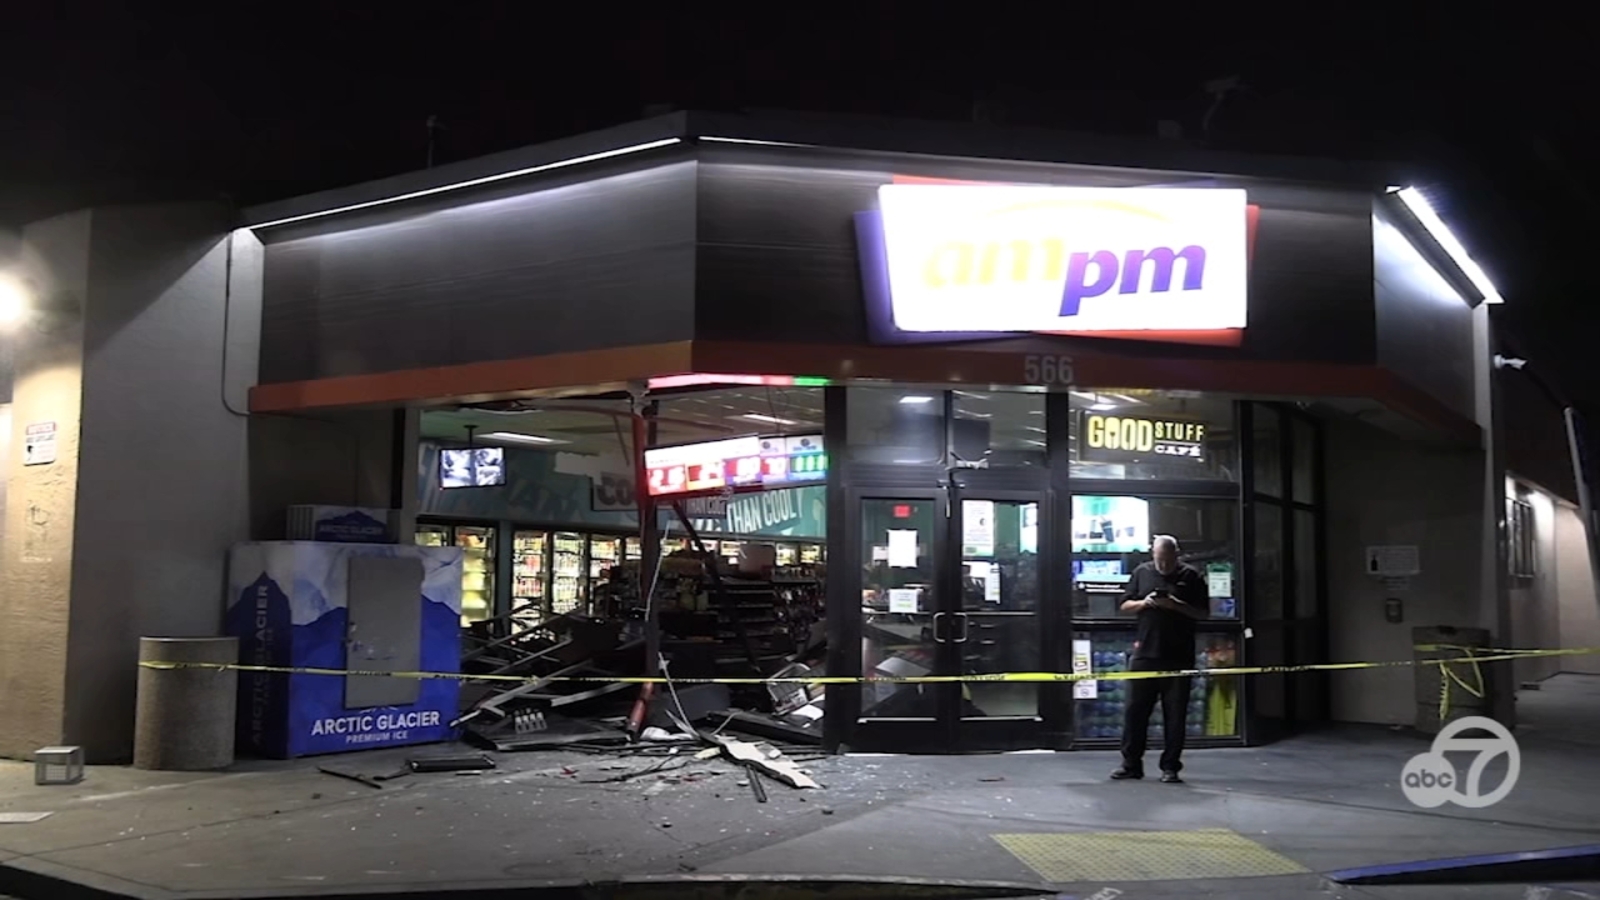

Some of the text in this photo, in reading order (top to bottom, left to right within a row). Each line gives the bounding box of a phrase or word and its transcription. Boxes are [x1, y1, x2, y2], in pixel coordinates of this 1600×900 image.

[921, 237, 1206, 317] ampm
[1024, 355, 1074, 384] 566
[1088, 415, 1204, 452] GOOD STUFF
[727, 495, 762, 534] THAN
[311, 710, 440, 736] ARCTIC GLACIER
[346, 730, 409, 743] PREMIUM ICE
